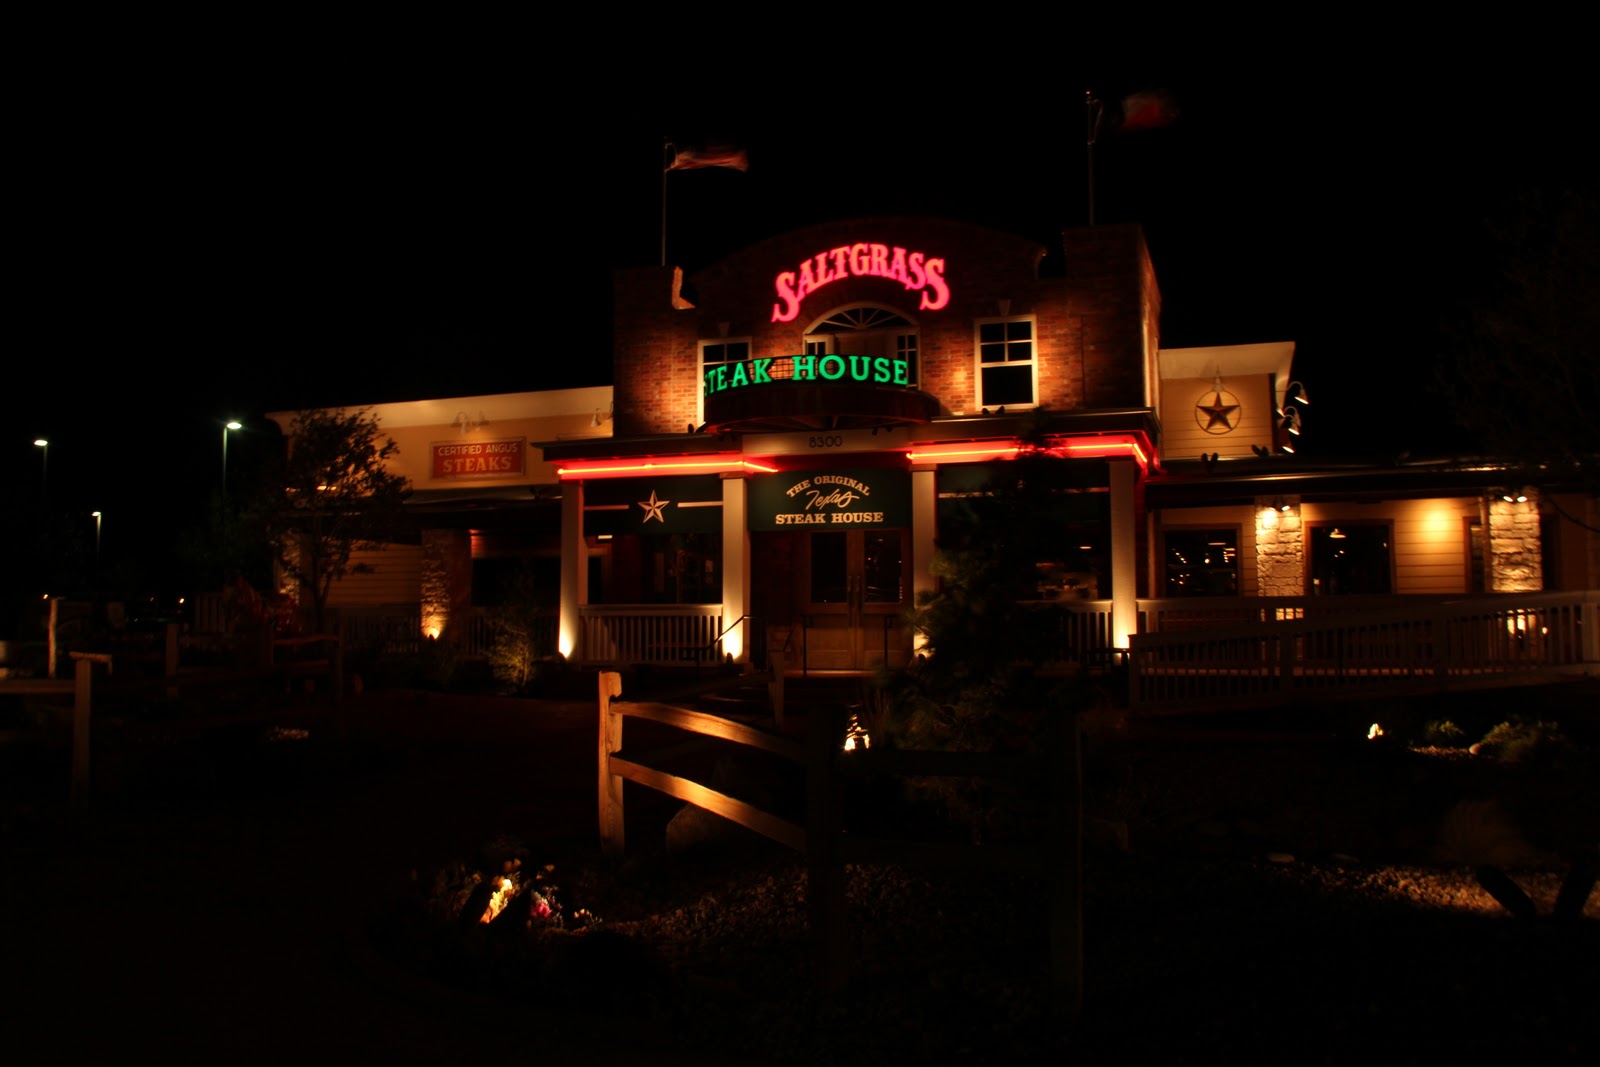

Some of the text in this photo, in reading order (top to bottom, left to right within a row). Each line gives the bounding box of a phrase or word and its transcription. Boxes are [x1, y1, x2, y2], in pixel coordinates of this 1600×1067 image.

[771, 243, 950, 323] SALTGRASS
[791, 355, 909, 385] HOUSE
[438, 442, 518, 456] CERTIFIED ANGUS
[808, 435, 843, 448] 8300
[443, 456, 512, 473] STEAKS
[786, 475, 871, 498] THE ORIGINAL
[805, 488, 860, 510] Texas
[775, 511, 884, 525] STEAK HOUSE
